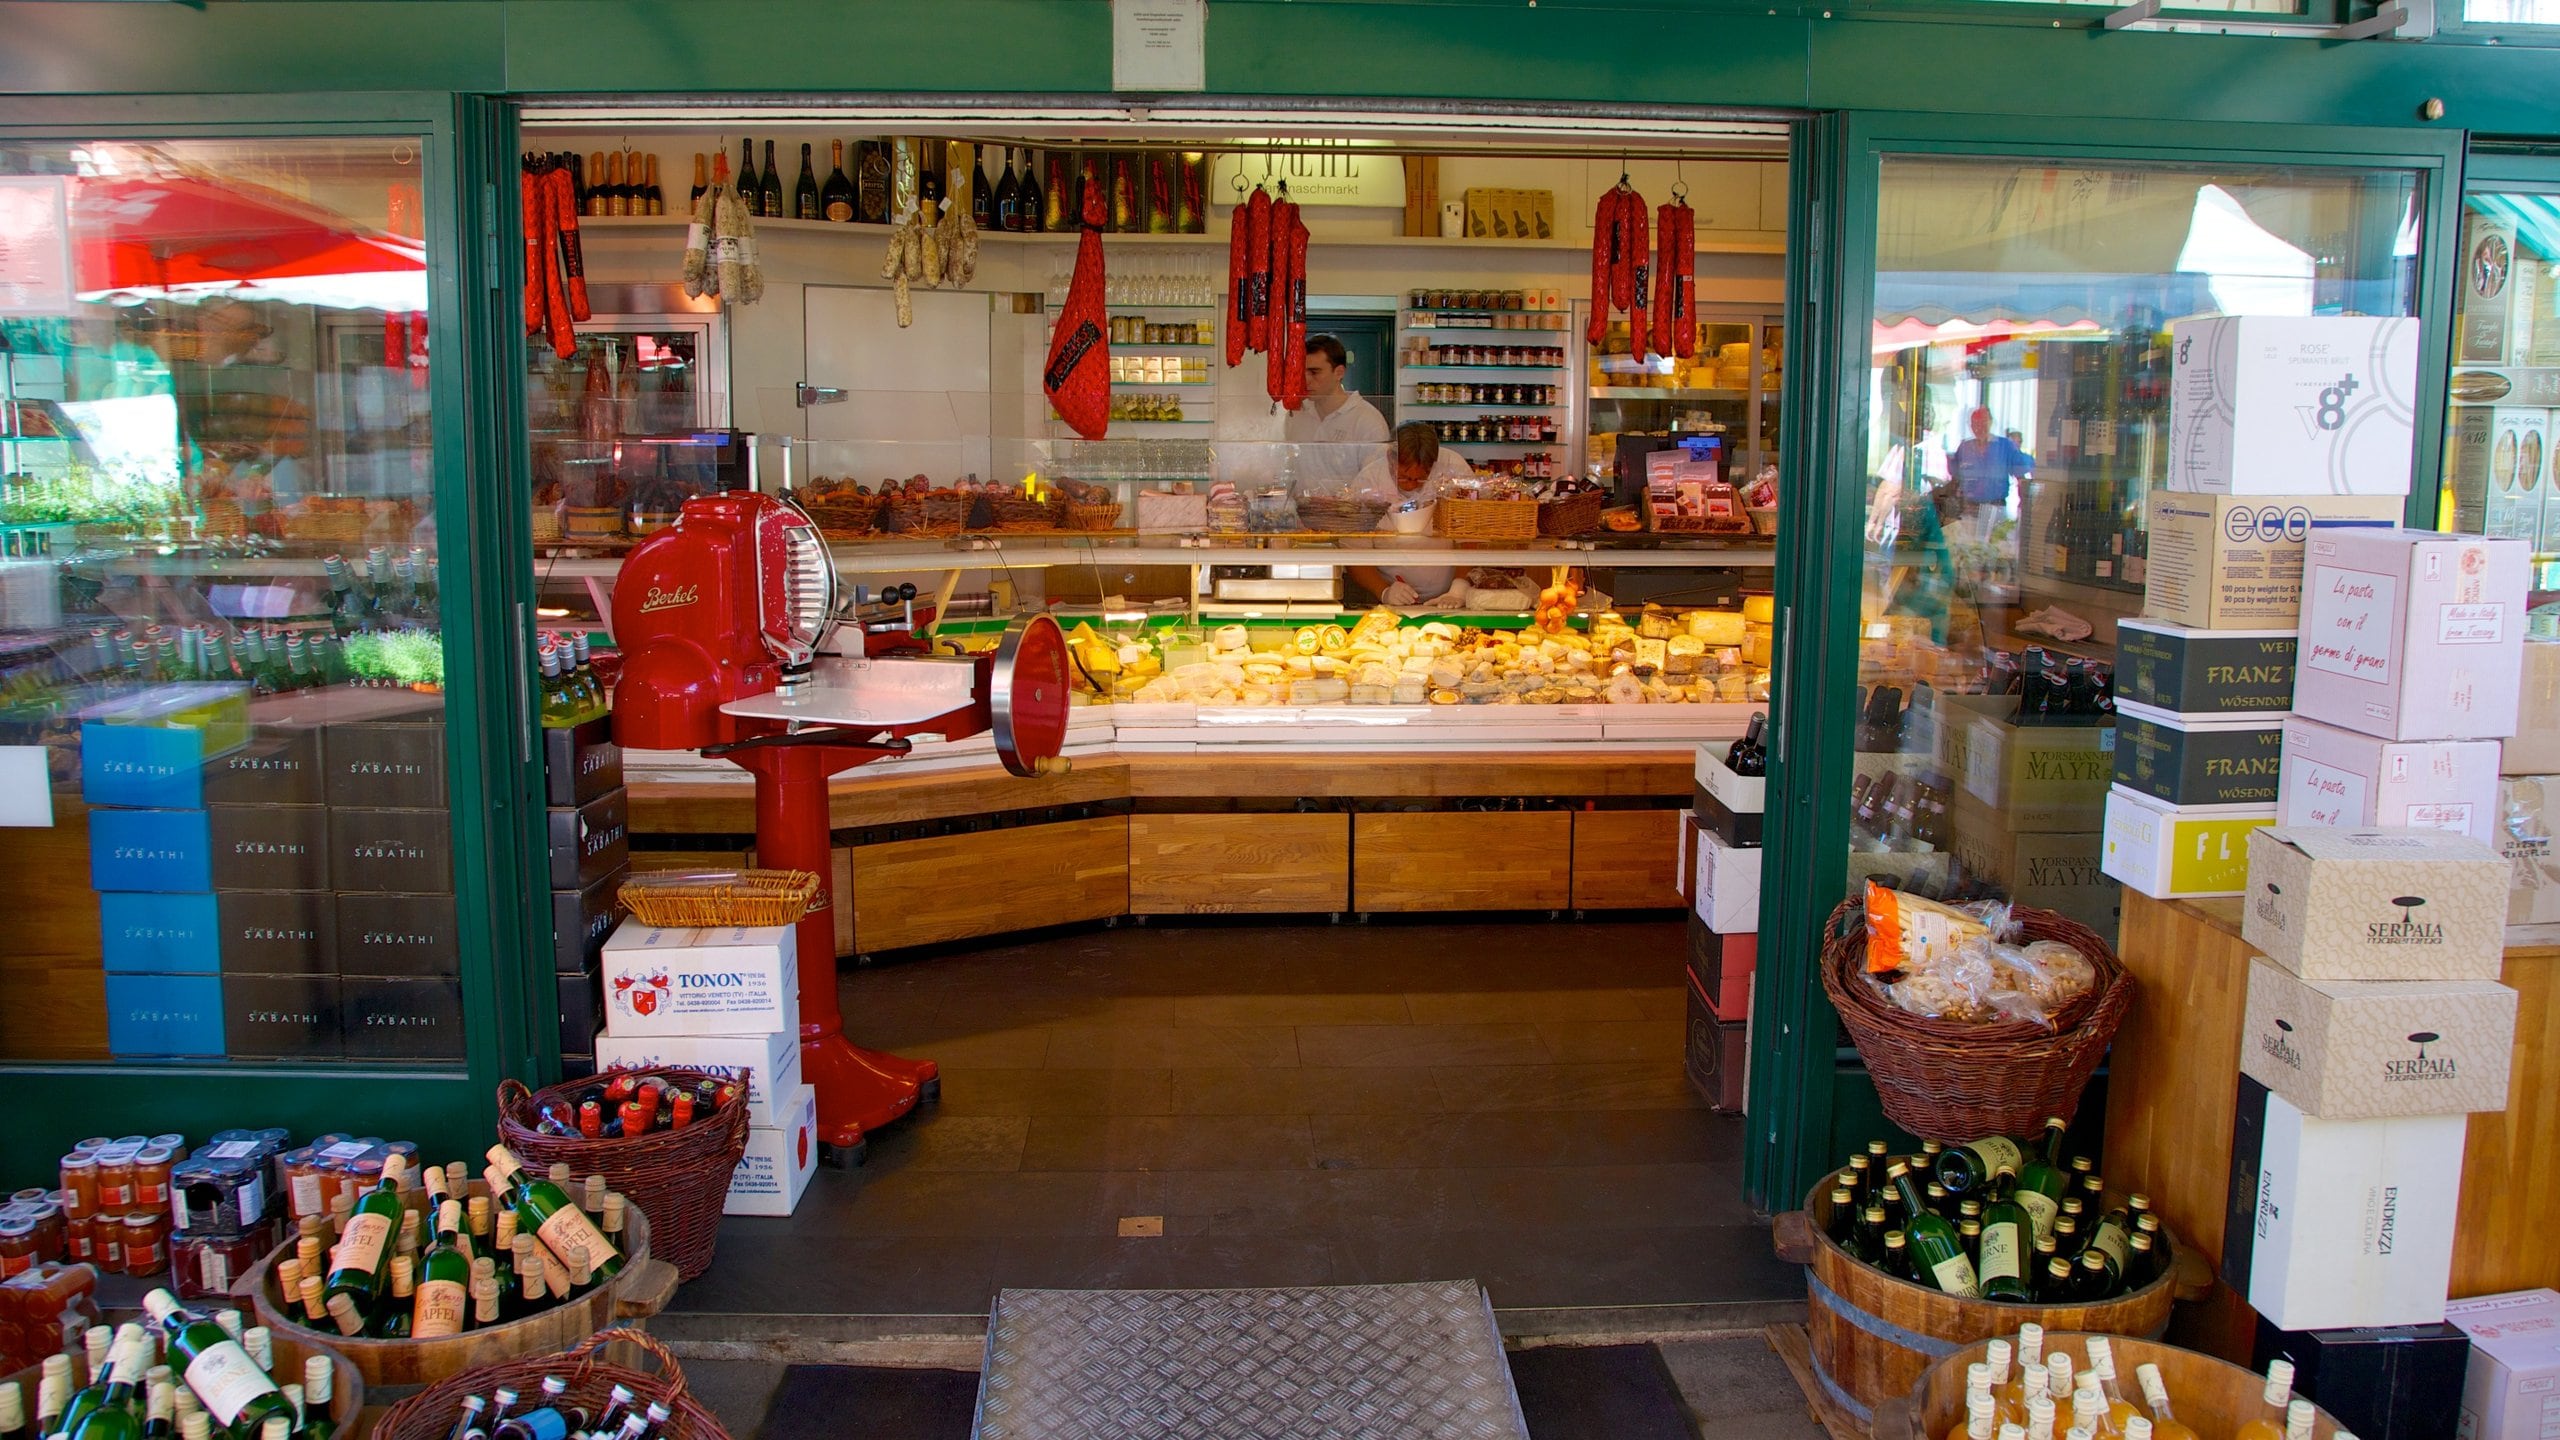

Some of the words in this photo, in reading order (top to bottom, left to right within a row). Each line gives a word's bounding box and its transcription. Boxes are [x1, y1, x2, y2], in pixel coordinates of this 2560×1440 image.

[1289, 184, 1360, 195] naschmarkt
[2152, 501, 2177, 521] eco
[2225, 505, 2312, 543] eco
[642, 584, 699, 610] Berkel
[2222, 585, 2233, 593] 100
[2247, 585, 2256, 594] by
[2258, 585, 2278, 594] weight
[2279, 585, 2289, 593] for
[2334, 577, 2344, 593] La
[2345, 583, 2374, 602] pasta
[2247, 595, 2255, 604] by
[2257, 595, 2278, 604] weight
[2279, 595, 2288, 603] for
[2447, 607, 2467, 618] Made
[2470, 609, 2478, 617] in
[2479, 606, 2497, 620] Italy
[2337, 616, 2351, 628] con
[2355, 613, 2368, 630] il
[2311, 643, 2341, 661] germe
[2344, 645, 2354, 661] di
[2355, 655, 2385, 671] grano
[350, 678, 413, 688] SABATH
[2207, 666, 2283, 684] FRANZ
[2220, 696, 2290, 707] WÖSENDOR
[229, 760, 299, 770] SABATHI
[351, 764, 421, 774] SABATHI
[2026, 762, 2100, 779] MAYR
[2206, 758, 2279, 776] FRANZ
[2307, 769, 2318, 785] La
[2319, 779, 2346, 795] pasta
[2311, 809, 2324, 821] con
[2329, 809, 2340, 825] il
[587, 824, 623, 856] SABATHI
[115, 849, 184, 860] SABATHI
[236, 845, 304, 854] SABATHI
[354, 848, 424, 858] SABATHI
[2030, 857, 2100, 875] VORSPANN
[2027, 867, 2101, 886] MAYR
[244, 930, 313, 939] SABATHI
[2366, 923, 2443, 938] SERPAIA
[364, 935, 433, 944] SABATHI
[678, 972, 744, 988] TONON
[636, 993, 643, 1003] P
[647, 1001, 654, 1010] T
[249, 1013, 317, 1023] SABATHI
[366, 1016, 435, 1026] SABATHI
[2262, 1034, 2301, 1064] SERPAIA
[2385, 1058, 2457, 1075] SERPAIA
[2258, 1170, 2272, 1240] ENDRIZZI
[2366, 1186, 2377, 1208] VINO
[2379, 1187, 2397, 1256] ENDRIZZI
[561, 1228, 593, 1256] APFEL
[2363, 1216, 2374, 1255] CULTURA
[1981, 1244, 2009, 1259] IRNE
[420, 1308, 457, 1321] APFEL
